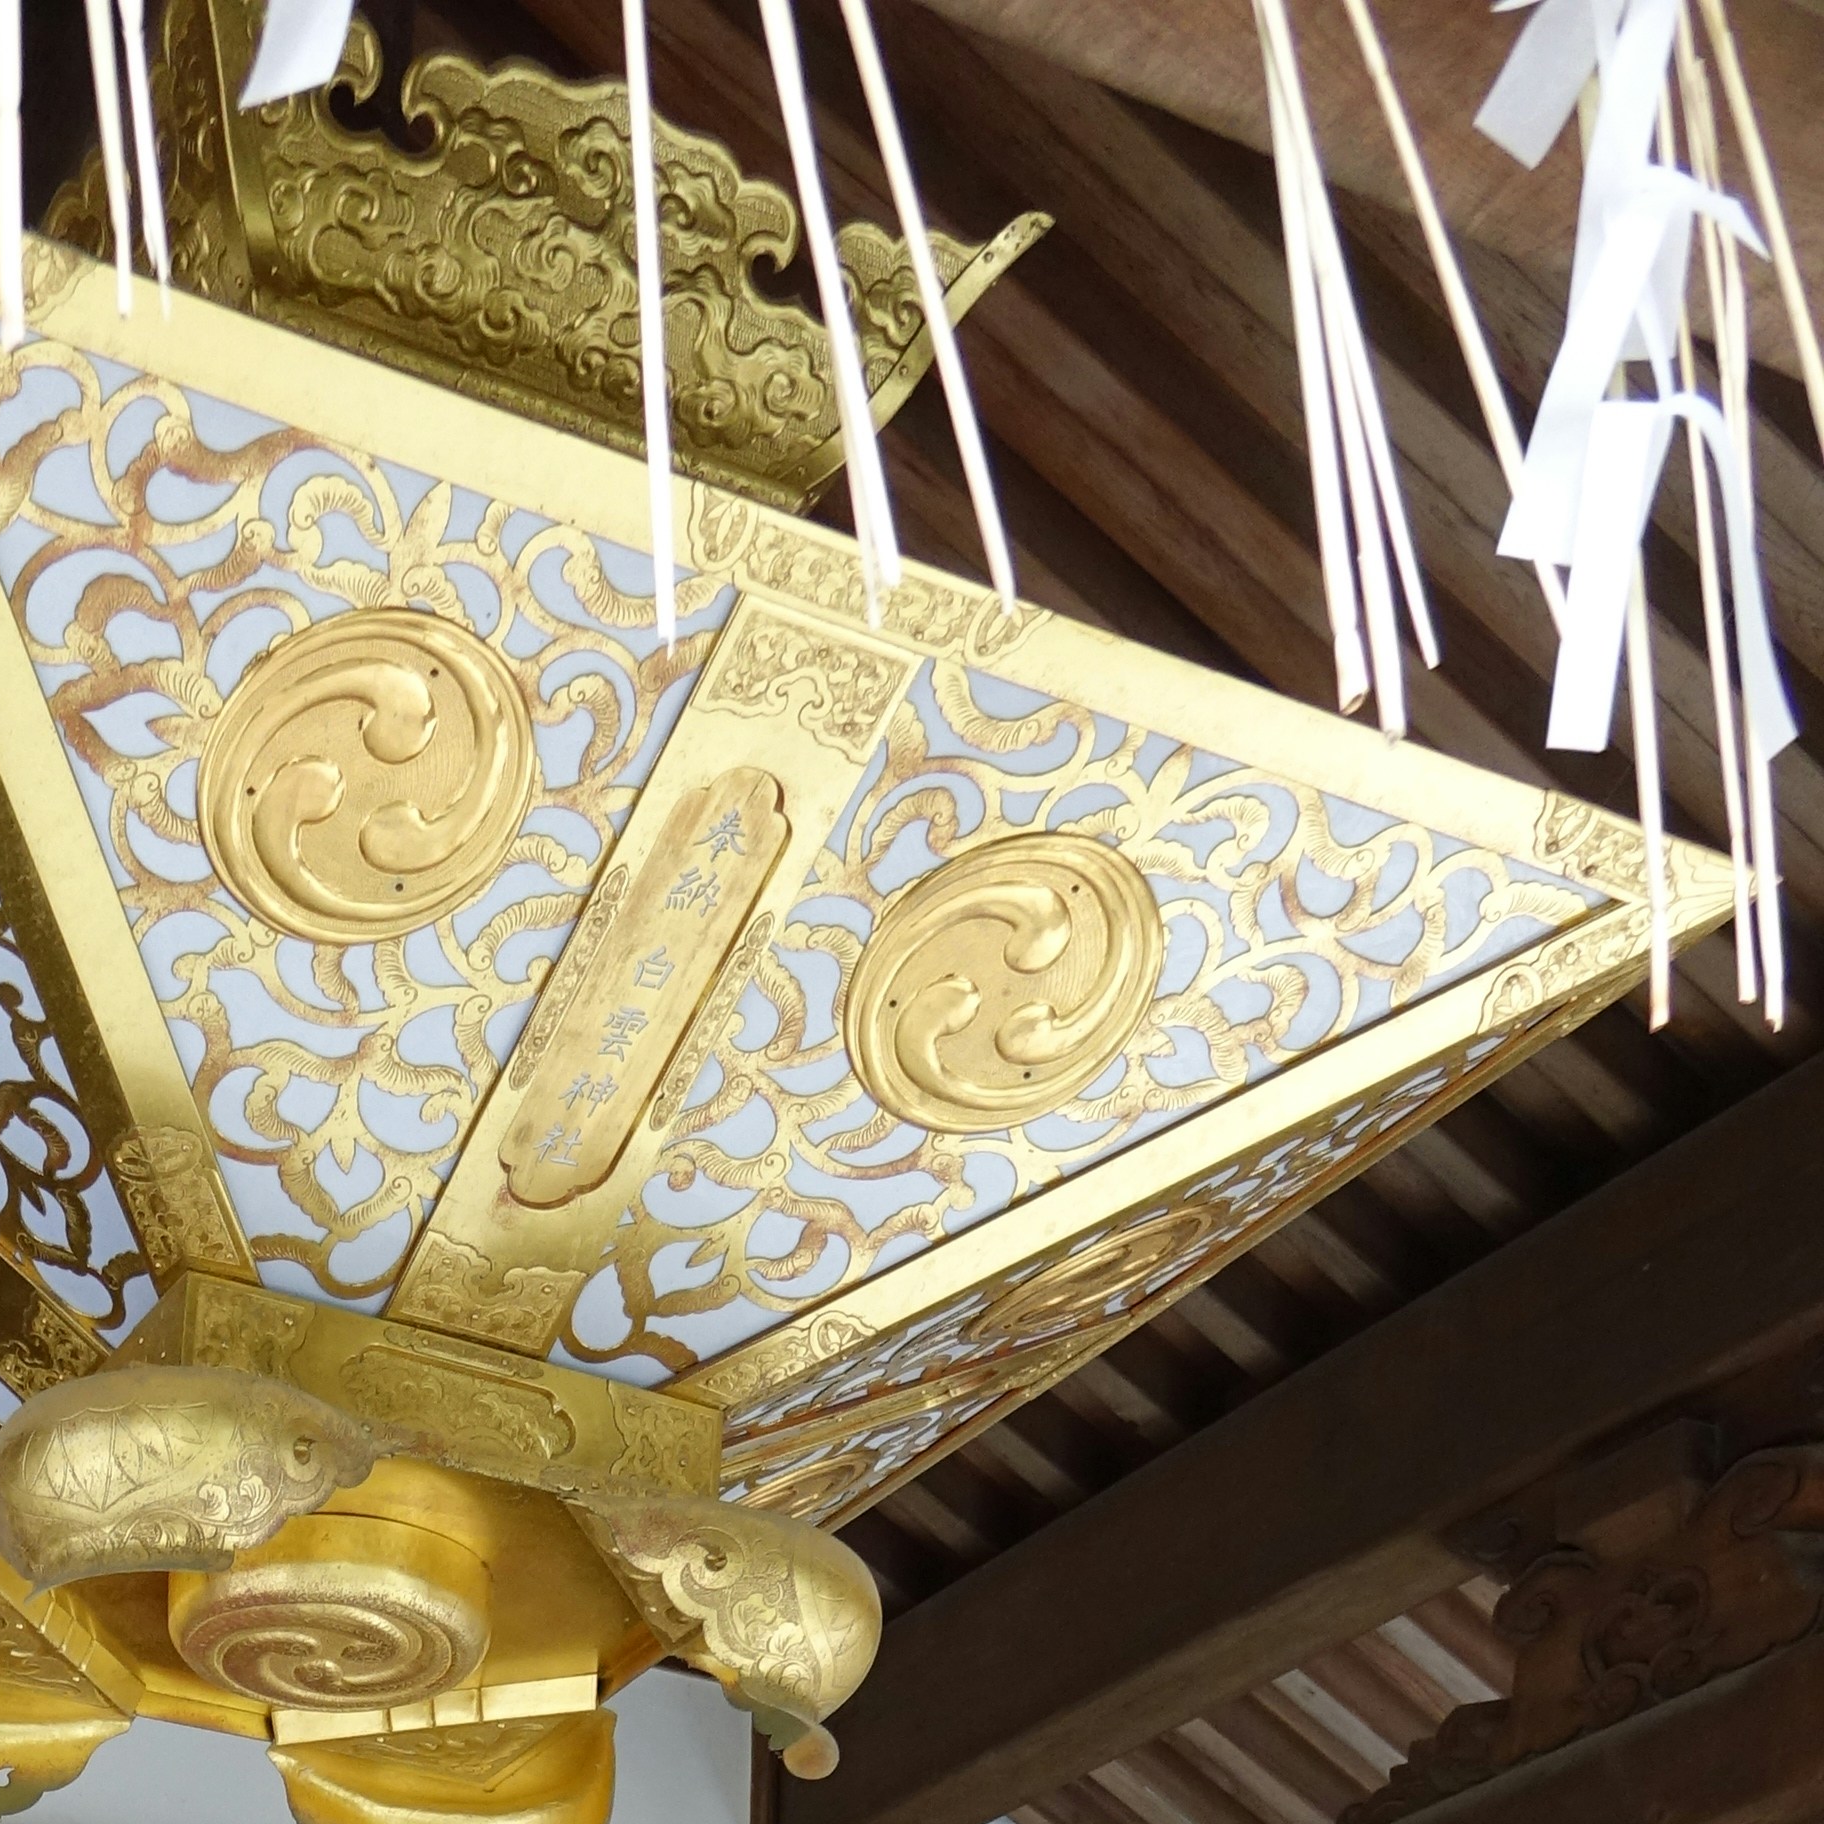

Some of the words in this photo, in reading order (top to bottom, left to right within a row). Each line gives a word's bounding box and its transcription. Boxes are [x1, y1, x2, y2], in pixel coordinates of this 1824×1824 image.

[664, 808, 747, 917] 奉納
[532, 945, 676, 1167] 白雲神社
